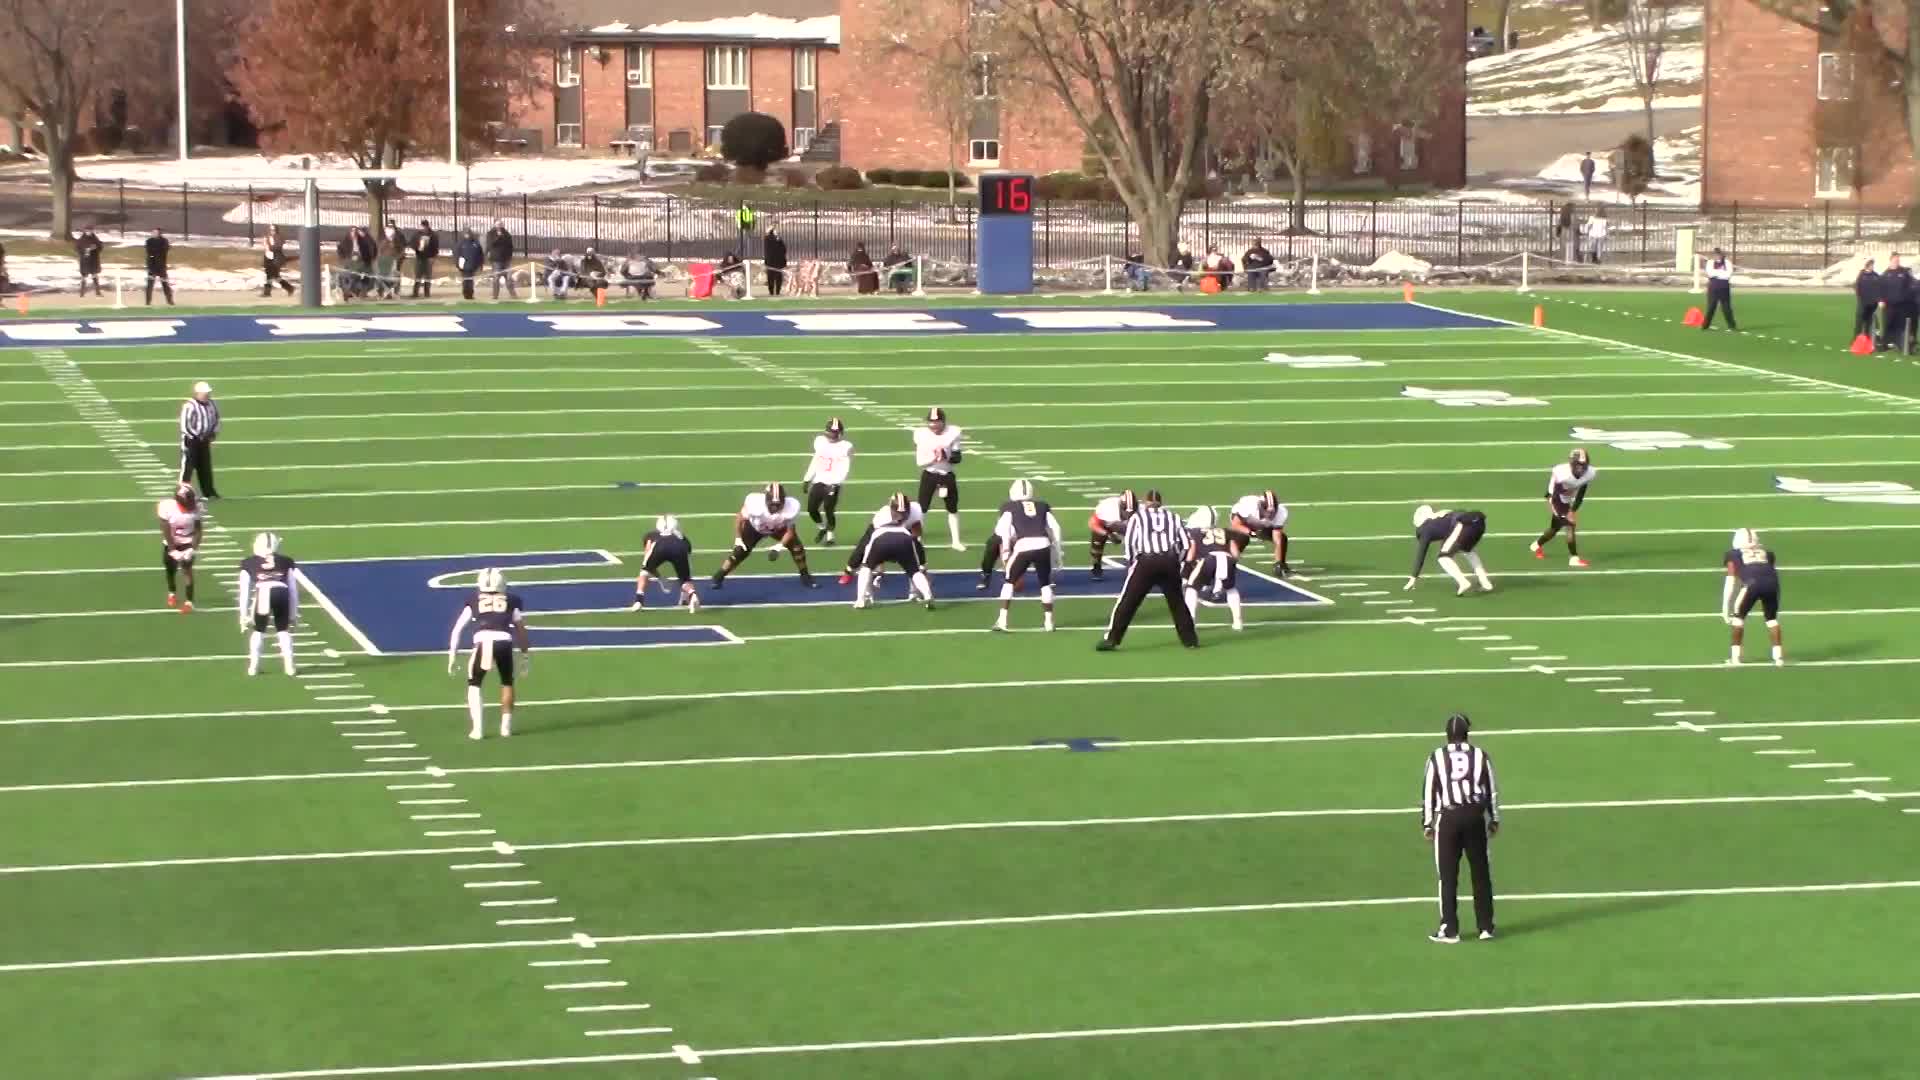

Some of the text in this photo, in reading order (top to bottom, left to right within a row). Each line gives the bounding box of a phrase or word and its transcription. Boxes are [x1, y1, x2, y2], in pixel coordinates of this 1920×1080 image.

[995, 178, 1031, 212] 16
[478, 593, 508, 613] 26
[1449, 751, 1470, 780] B
